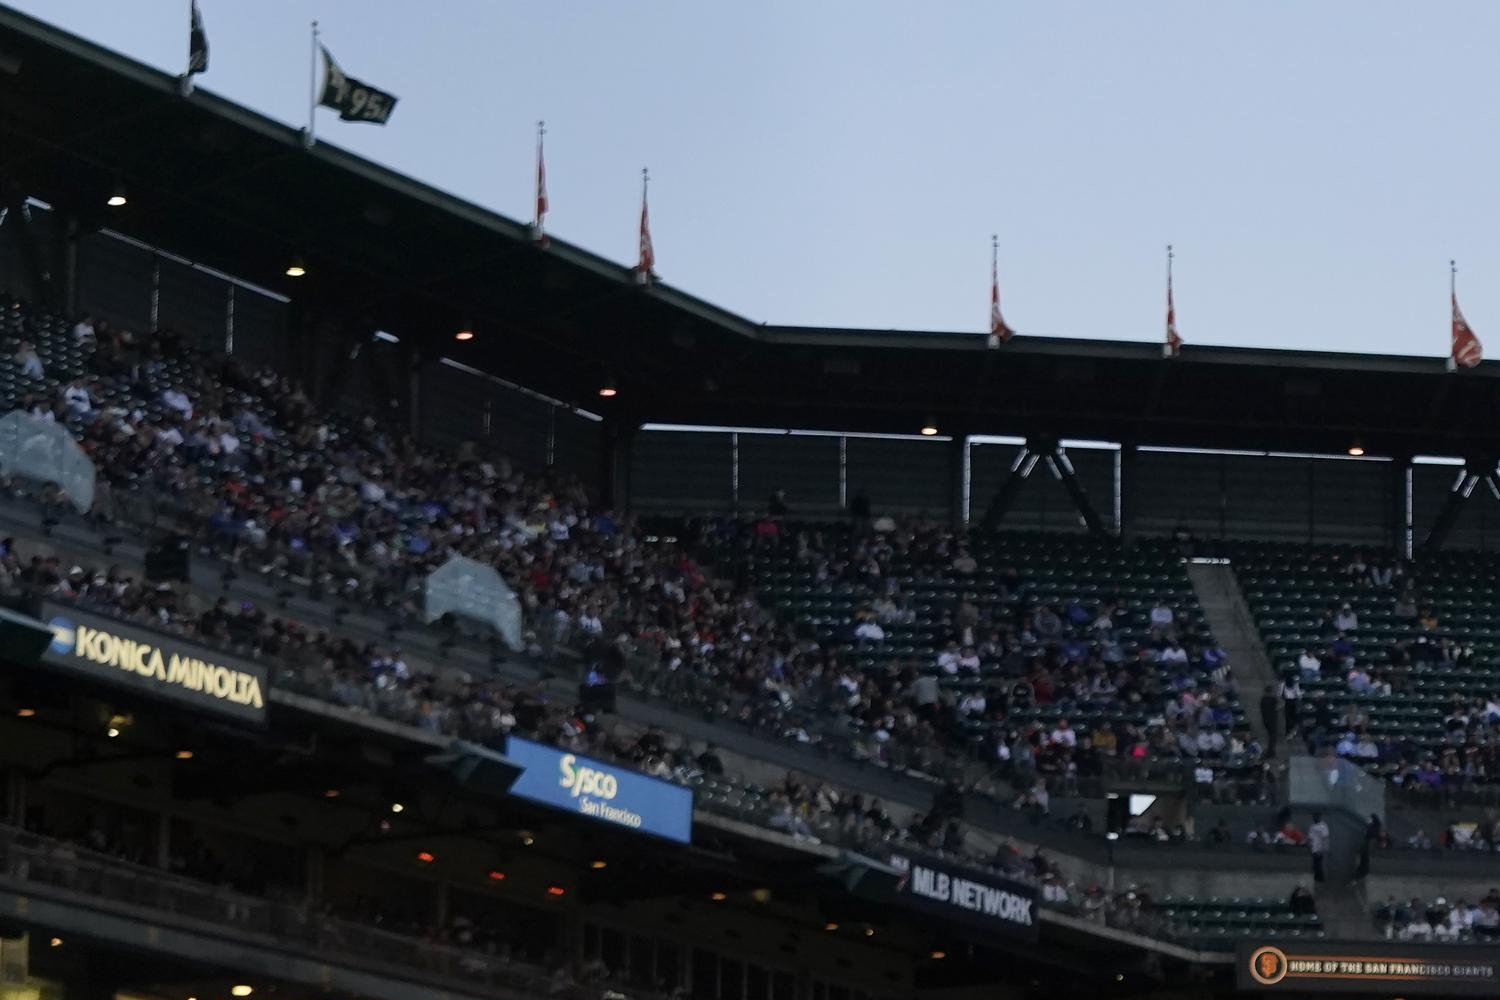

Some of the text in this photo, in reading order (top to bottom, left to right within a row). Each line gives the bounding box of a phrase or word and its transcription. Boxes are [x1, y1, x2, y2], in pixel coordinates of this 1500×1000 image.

[76, 625, 263, 709] KONICA MINOLTA
[560, 754, 617, 799] Sysco
[580, 797, 641, 828] San Francisco
[912, 866, 1032, 926] MLB NETWORK
[1289, 960, 1493, 977] HOME OF THE SAN FRANCISCO GIANTS
